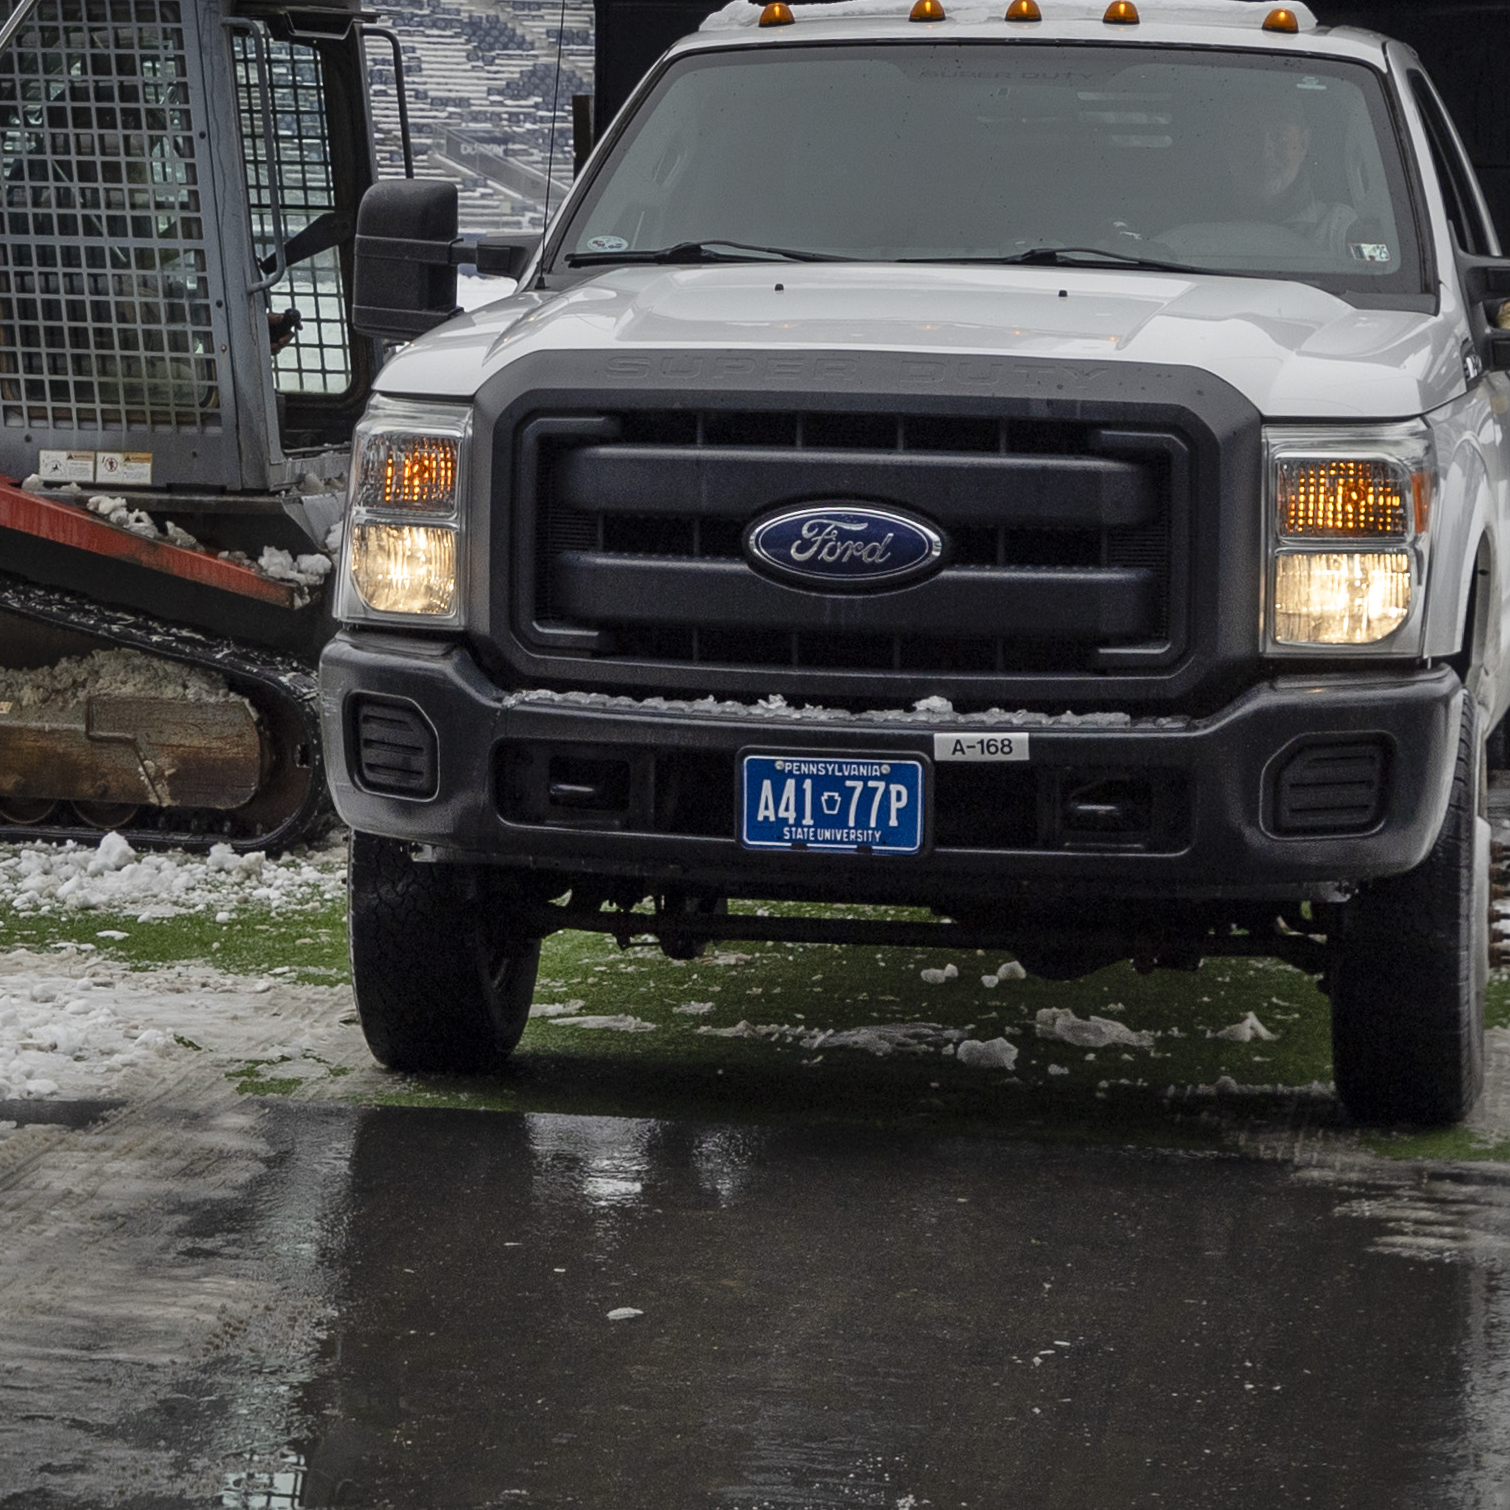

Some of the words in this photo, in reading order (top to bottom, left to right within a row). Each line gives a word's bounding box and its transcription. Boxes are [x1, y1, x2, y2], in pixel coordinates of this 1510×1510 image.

[604, 355, 859, 382] SUPER
[899, 359, 1109, 388] DUTY
[790, 519, 894, 564] Ford
[951, 739, 1014, 756] A-168
[784, 763, 881, 777] PENNSYLVANIA
[783, 827, 815, 840] STATE
[817, 829, 882, 842] UNIVERSITY
